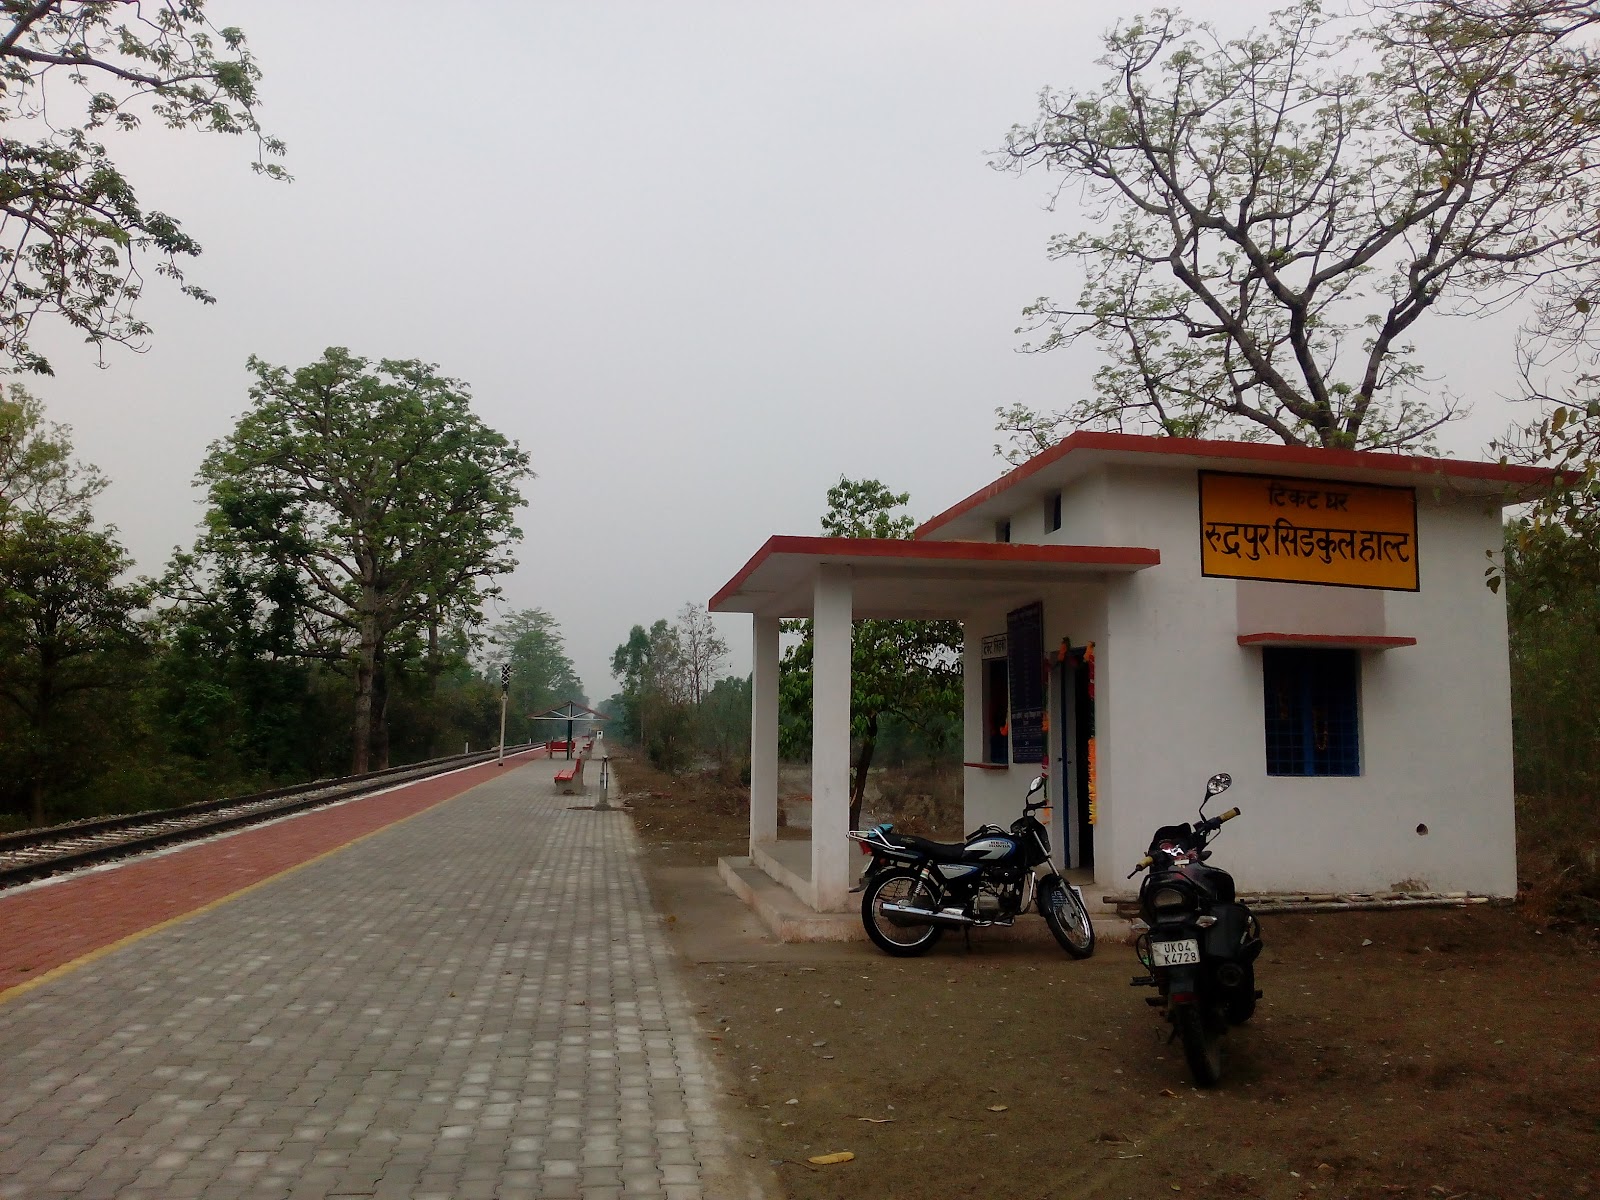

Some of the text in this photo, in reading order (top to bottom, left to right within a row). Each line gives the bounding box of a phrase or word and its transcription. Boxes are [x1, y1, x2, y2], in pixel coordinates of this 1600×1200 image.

[1267, 483, 1351, 512] टिकट घर
[1205, 518, 1410, 564] रुद्रपुर सिडकुल हाल्ट
[1164, 952, 1197, 964] K4728
